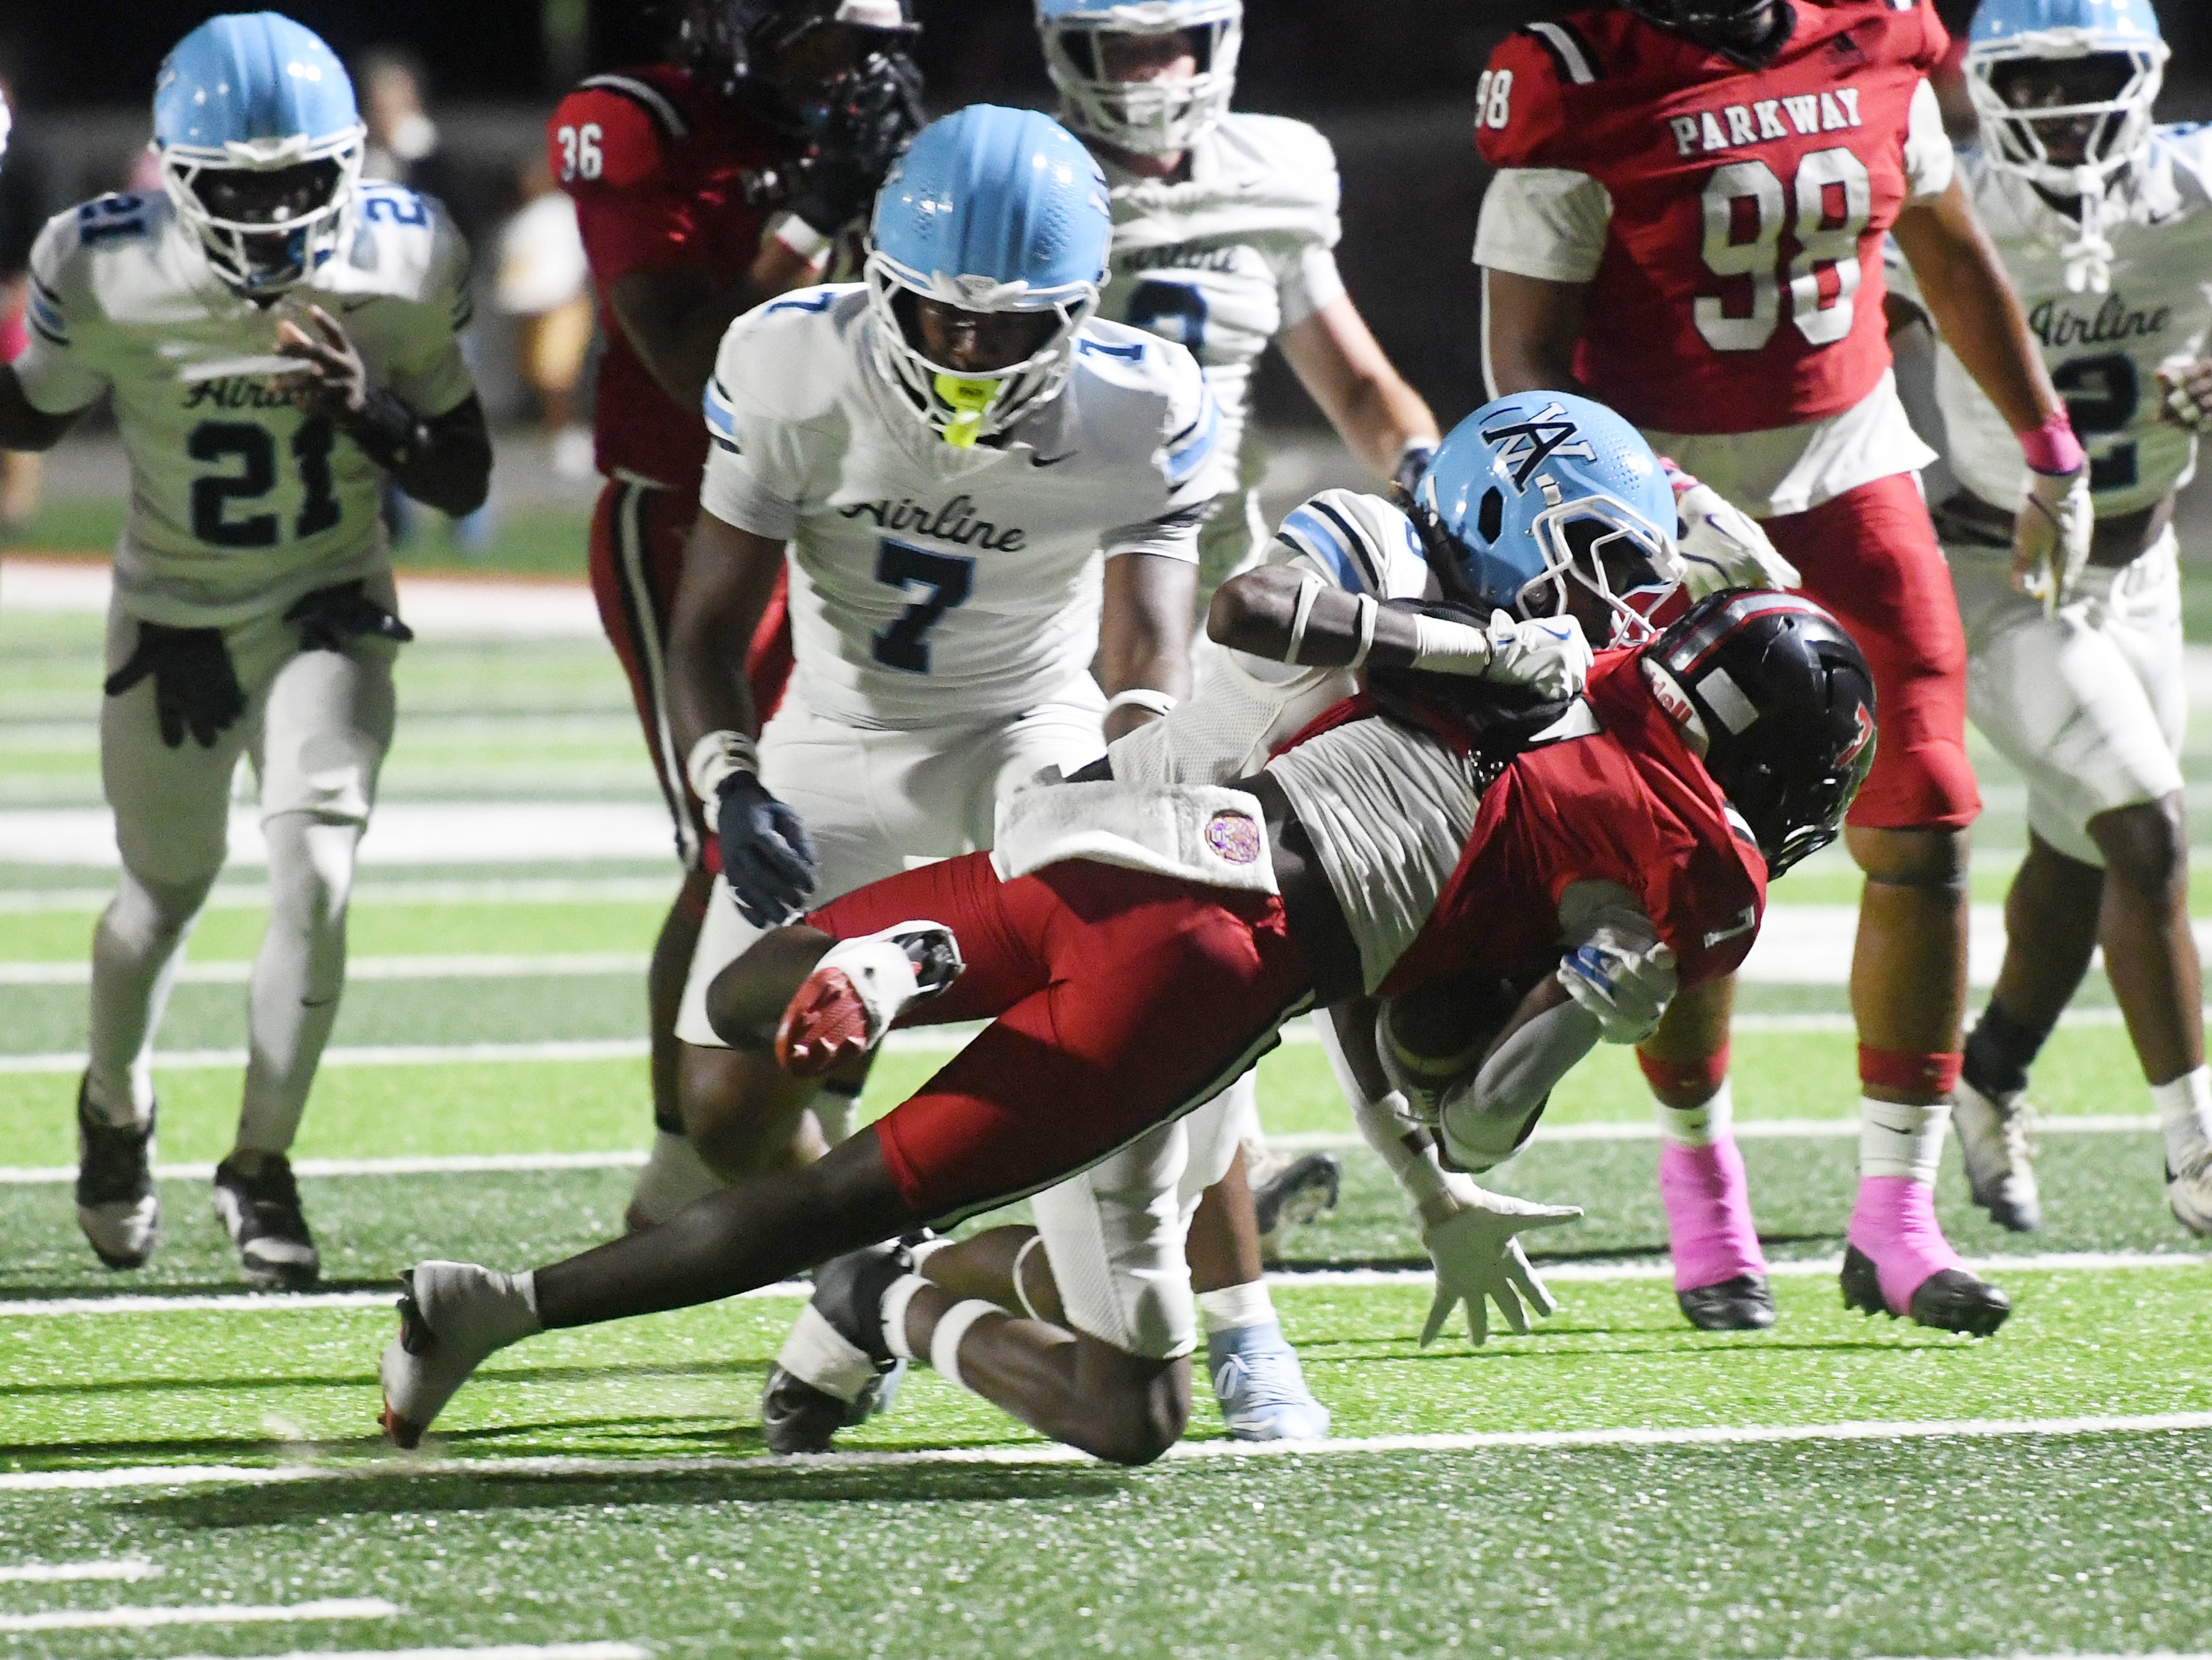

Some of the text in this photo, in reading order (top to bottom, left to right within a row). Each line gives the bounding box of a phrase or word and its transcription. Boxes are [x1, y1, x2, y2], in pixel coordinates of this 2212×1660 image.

[1474, 69, 1514, 130] 98
[1670, 87, 1862, 156] PARKWAY
[557, 122, 604, 183] 36
[362, 189, 428, 228] 2
[1693, 146, 1871, 351] 98
[2052, 351, 2140, 492] 2
[187, 417, 343, 549] 21
[839, 494, 1027, 553] Airline
[872, 536, 978, 677] 7
